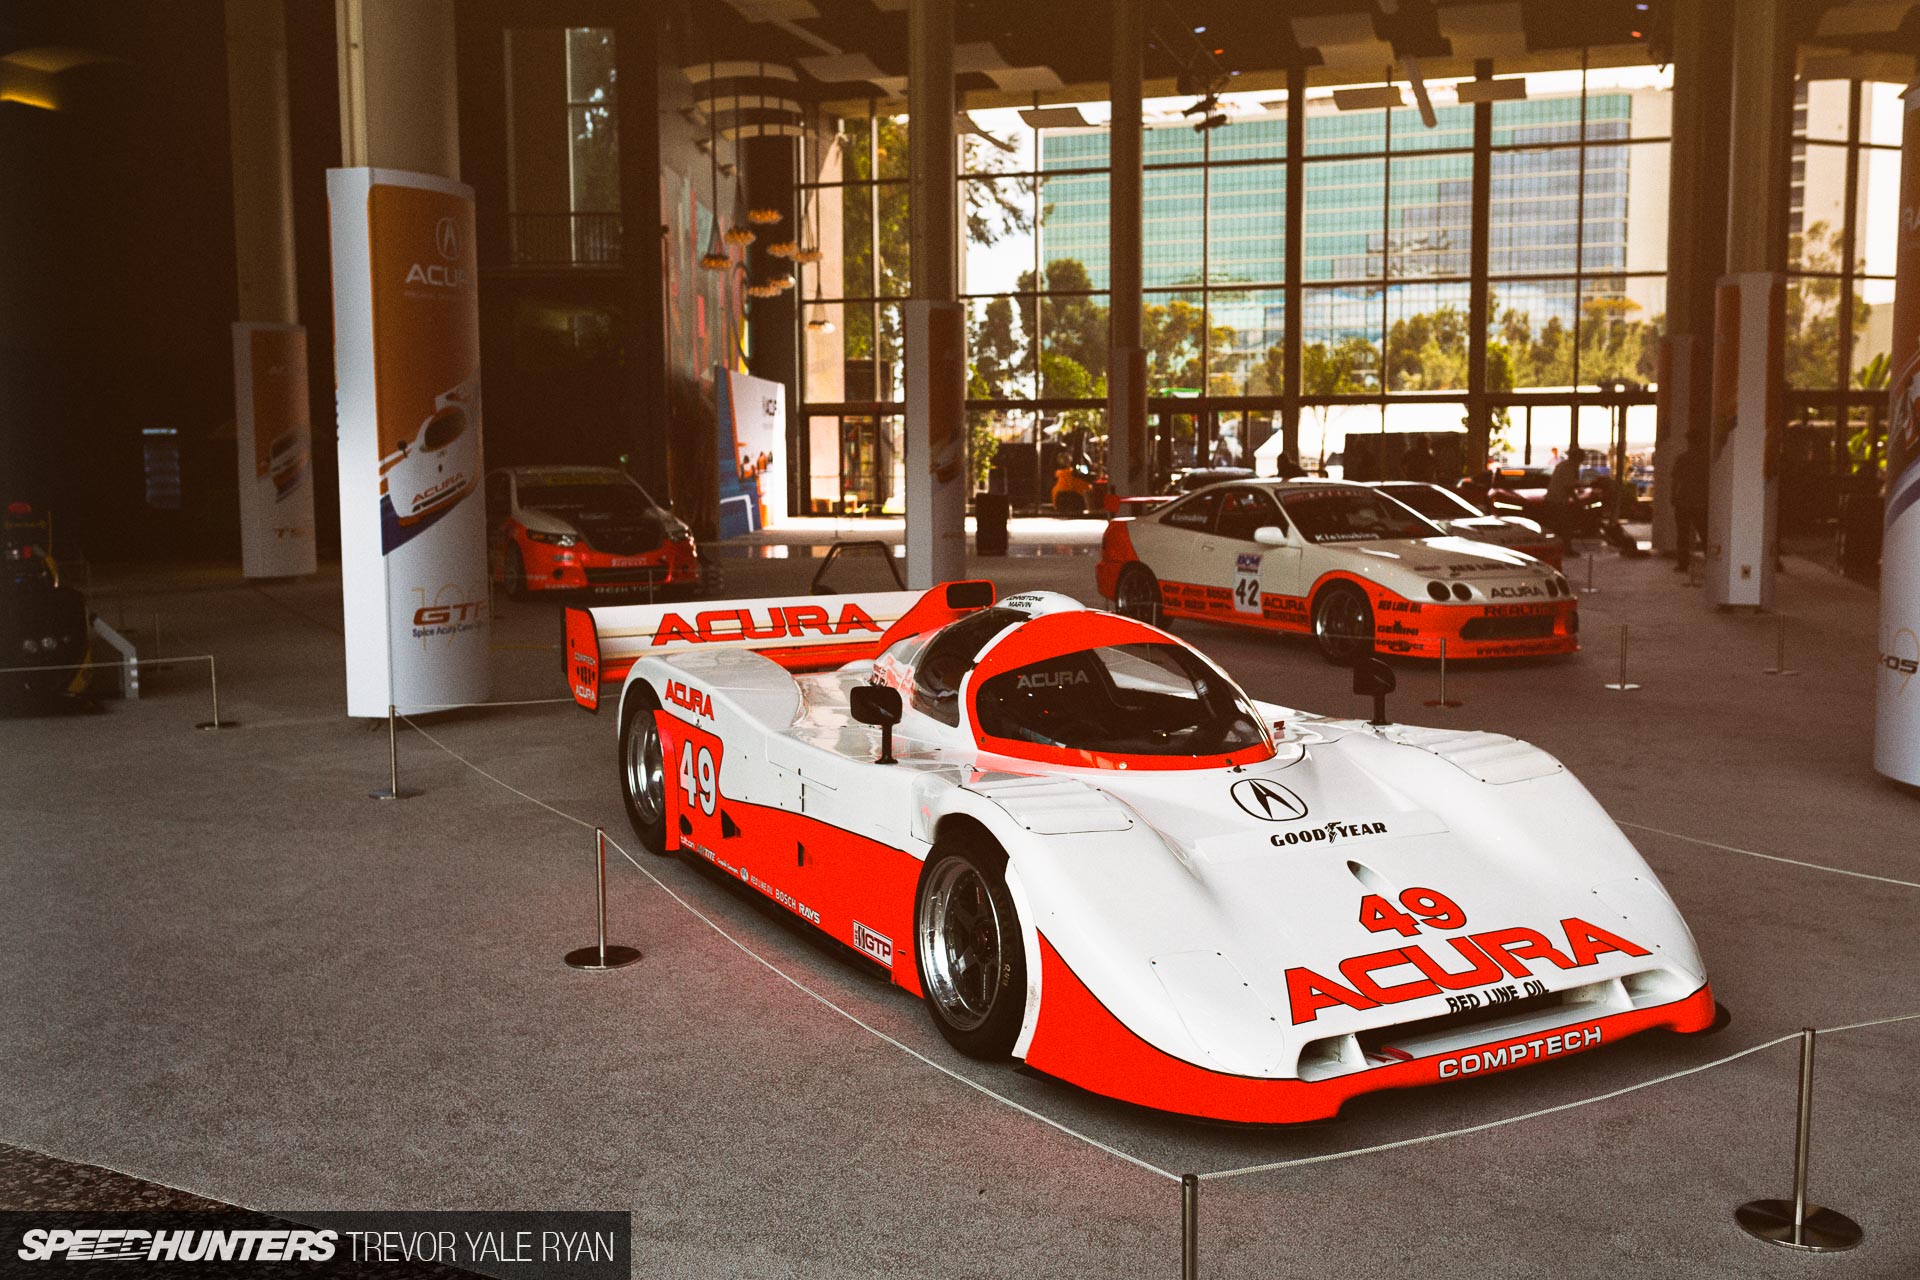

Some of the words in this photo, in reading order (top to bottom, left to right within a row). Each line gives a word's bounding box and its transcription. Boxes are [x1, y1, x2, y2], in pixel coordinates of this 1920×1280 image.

[405, 263, 466, 287] ACU
[1235, 578, 1260, 607] 42
[1263, 597, 1307, 612] ACURA
[1491, 586, 1545, 599] ACURA
[651, 603, 885, 647] ACURA
[1016, 669, 1090, 689] ACURA
[575, 684, 597, 702] ACURA
[664, 678, 715, 722] ACURA
[679, 738, 717, 817] 49
[775, 887, 797, 910] BOSCH
[1359, 886, 1468, 938] 49
[798, 902, 821, 925] RAYS
[865, 933, 892, 958] GTP
[1284, 917, 1655, 1026] ACURA
[1445, 992, 1481, 1015] RED
[1486, 984, 1520, 1007] LINE
[1523, 979, 1550, 1001] OIL
[1437, 1025, 1603, 1080] COMPTECH
